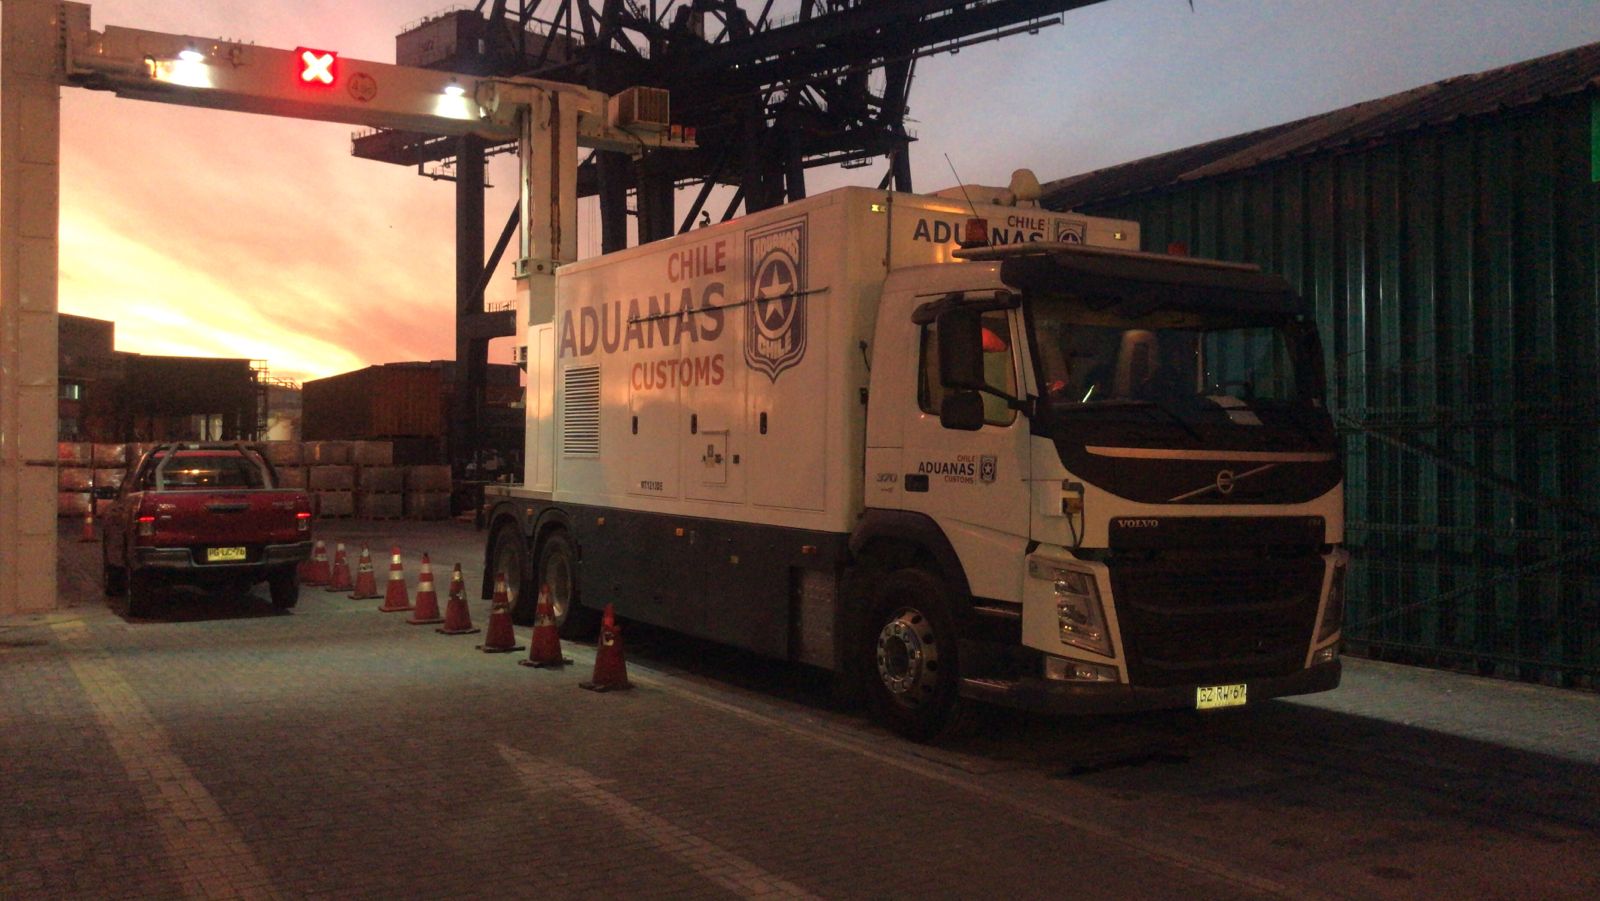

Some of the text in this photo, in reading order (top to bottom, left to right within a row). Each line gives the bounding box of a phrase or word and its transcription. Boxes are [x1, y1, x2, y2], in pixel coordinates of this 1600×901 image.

[1007, 215, 1045, 231] CHILE
[913, 219, 1043, 246] ADUNAS
[667, 240, 726, 283] CHILE
[559, 282, 726, 358] ADUANAS
[631, 353, 725, 391] CUSTOMS
[957, 455, 975, 463] CHILE
[918, 462, 975, 475] ADUANAS
[944, 475, 974, 484] CUSTOMS
[1118, 519, 1158, 528] VOLVO
